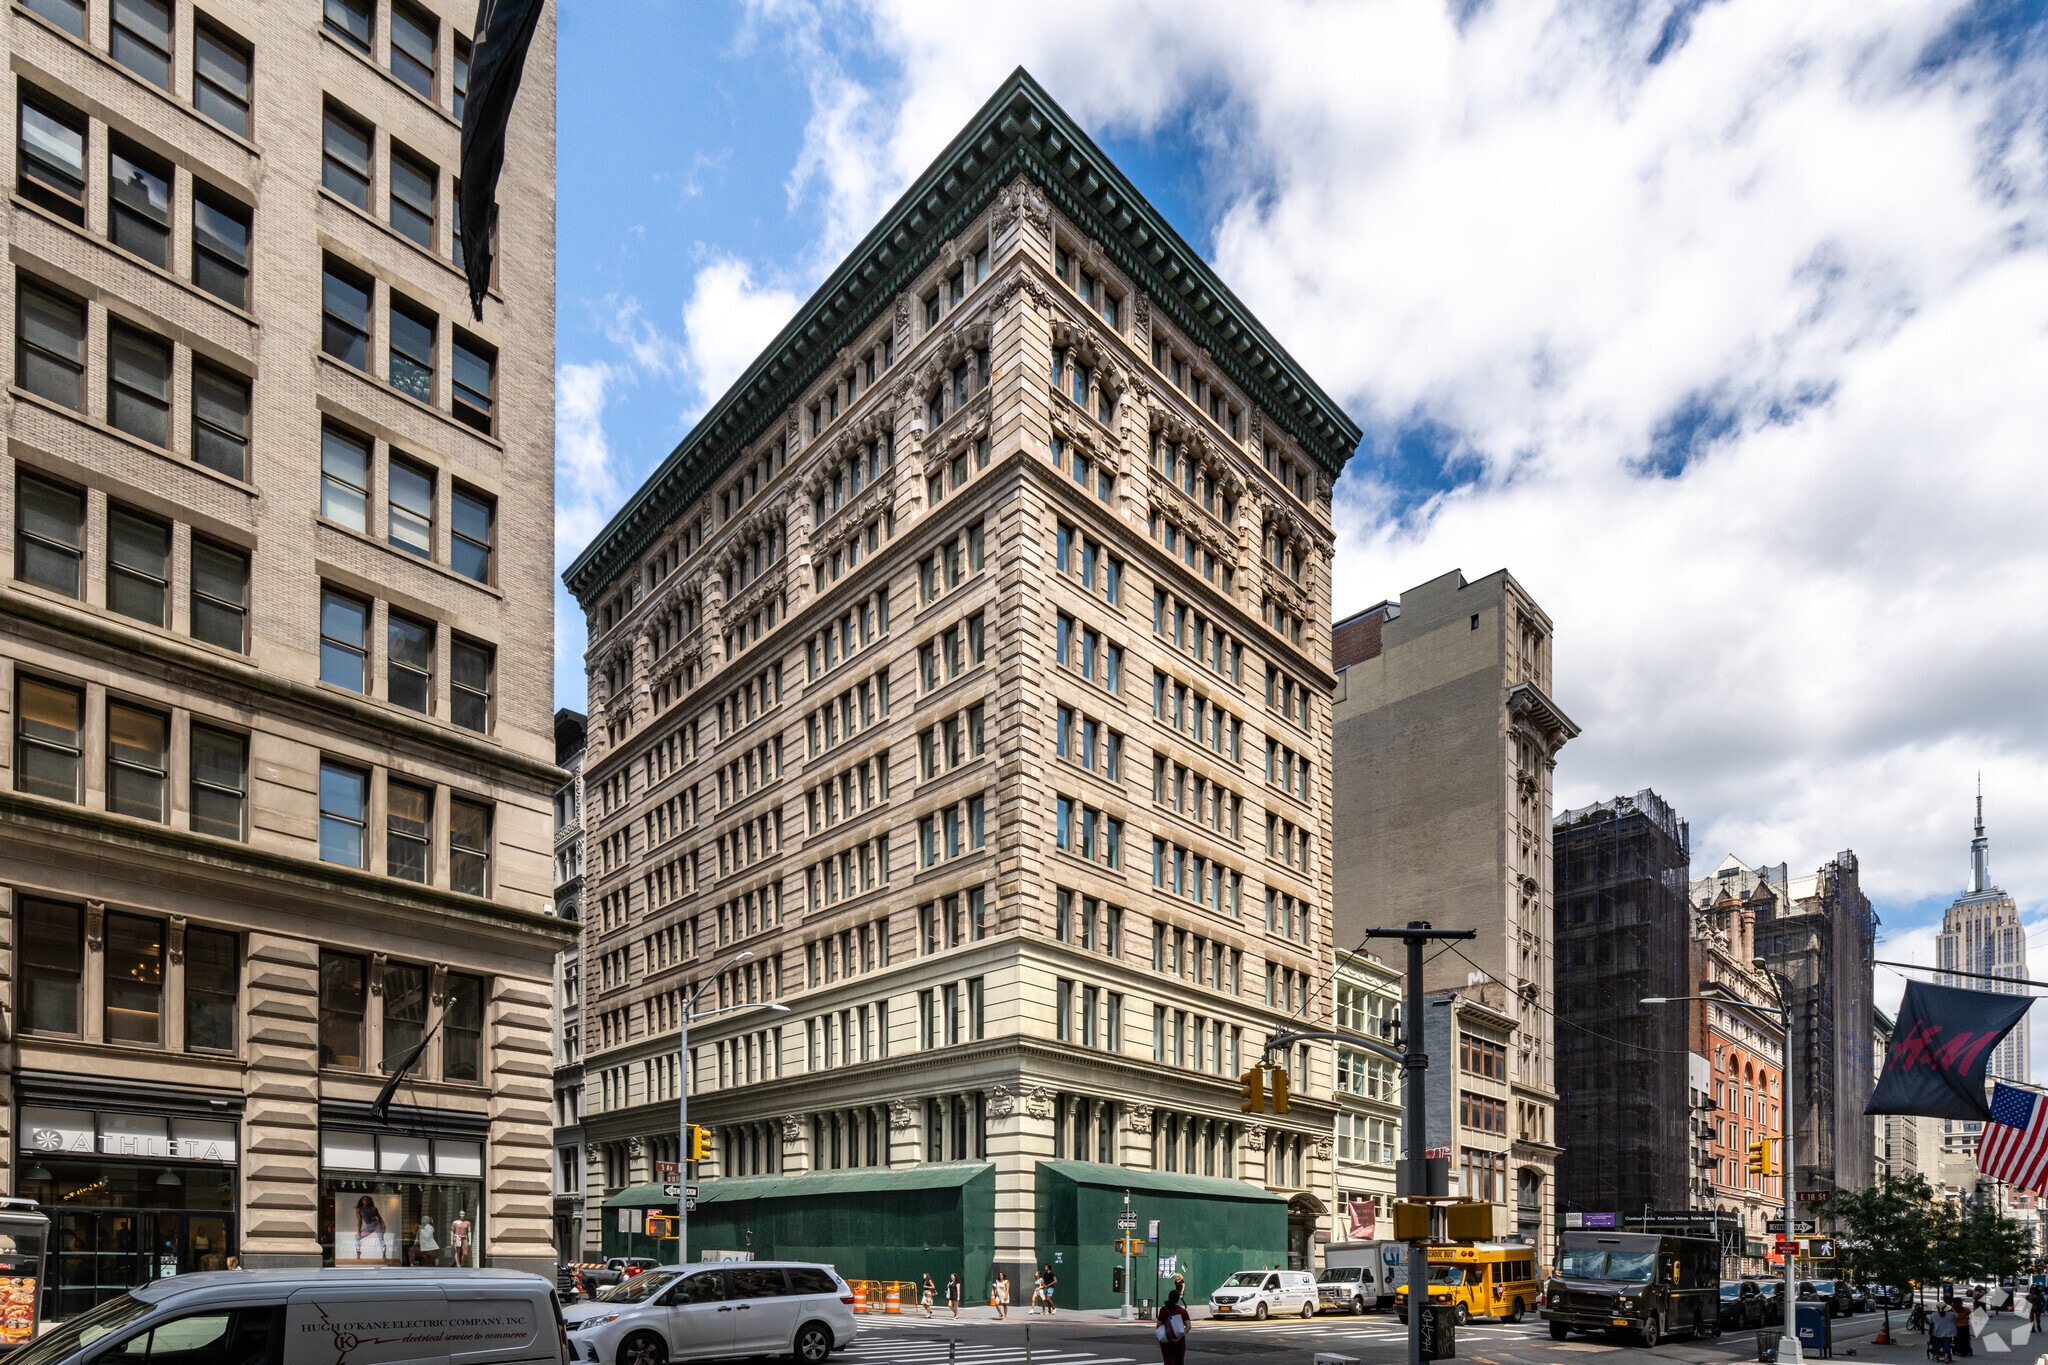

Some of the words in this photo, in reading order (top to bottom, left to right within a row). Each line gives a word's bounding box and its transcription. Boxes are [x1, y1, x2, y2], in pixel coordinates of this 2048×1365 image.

[1887, 1018, 2001, 1077] H&M
[71, 1132, 223, 1161] ATHLETA
[301, 1323, 340, 1333] HUGH
[344, 1321, 390, 1331] O'KANE
[393, 1319, 449, 1329] ELECTRIC
[449, 1318, 505, 1327] COMPANY,
[507, 1317, 527, 1325] INC.
[340, 1336, 354, 1349] K
[402, 1331, 444, 1343] electrical
[444, 1332, 473, 1341] service
[474, 1332, 483, 1340] to
[485, 1331, 528, 1340] commerce
